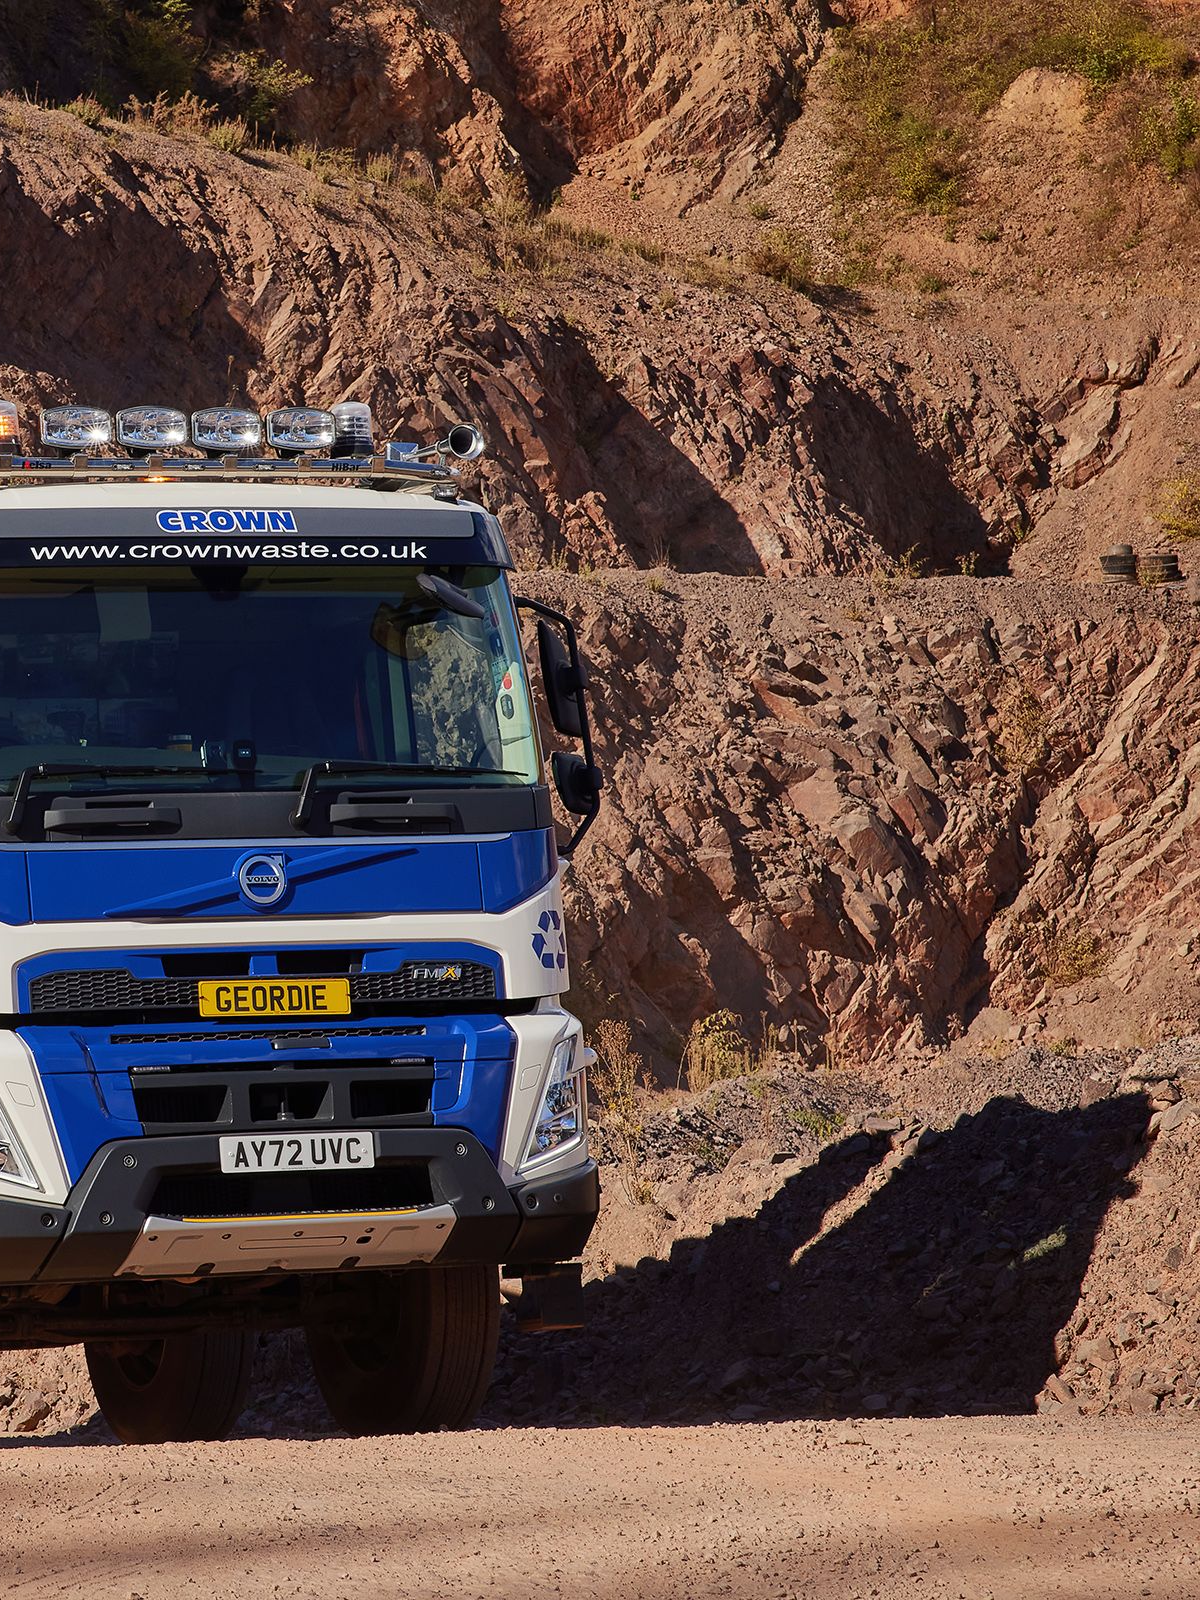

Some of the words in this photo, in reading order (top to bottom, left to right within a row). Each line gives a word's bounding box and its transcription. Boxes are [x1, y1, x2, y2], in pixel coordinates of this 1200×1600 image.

[331, 462, 360, 471] HiBar
[156, 509, 298, 533] CROWN
[30, 541, 428, 560] www.crownwaste.co.uk
[413, 965, 462, 981] FMX
[215, 984, 328, 1012] GEORDIE
[234, 1140, 303, 1168] AY72
[310, 1137, 362, 1164] UVC
